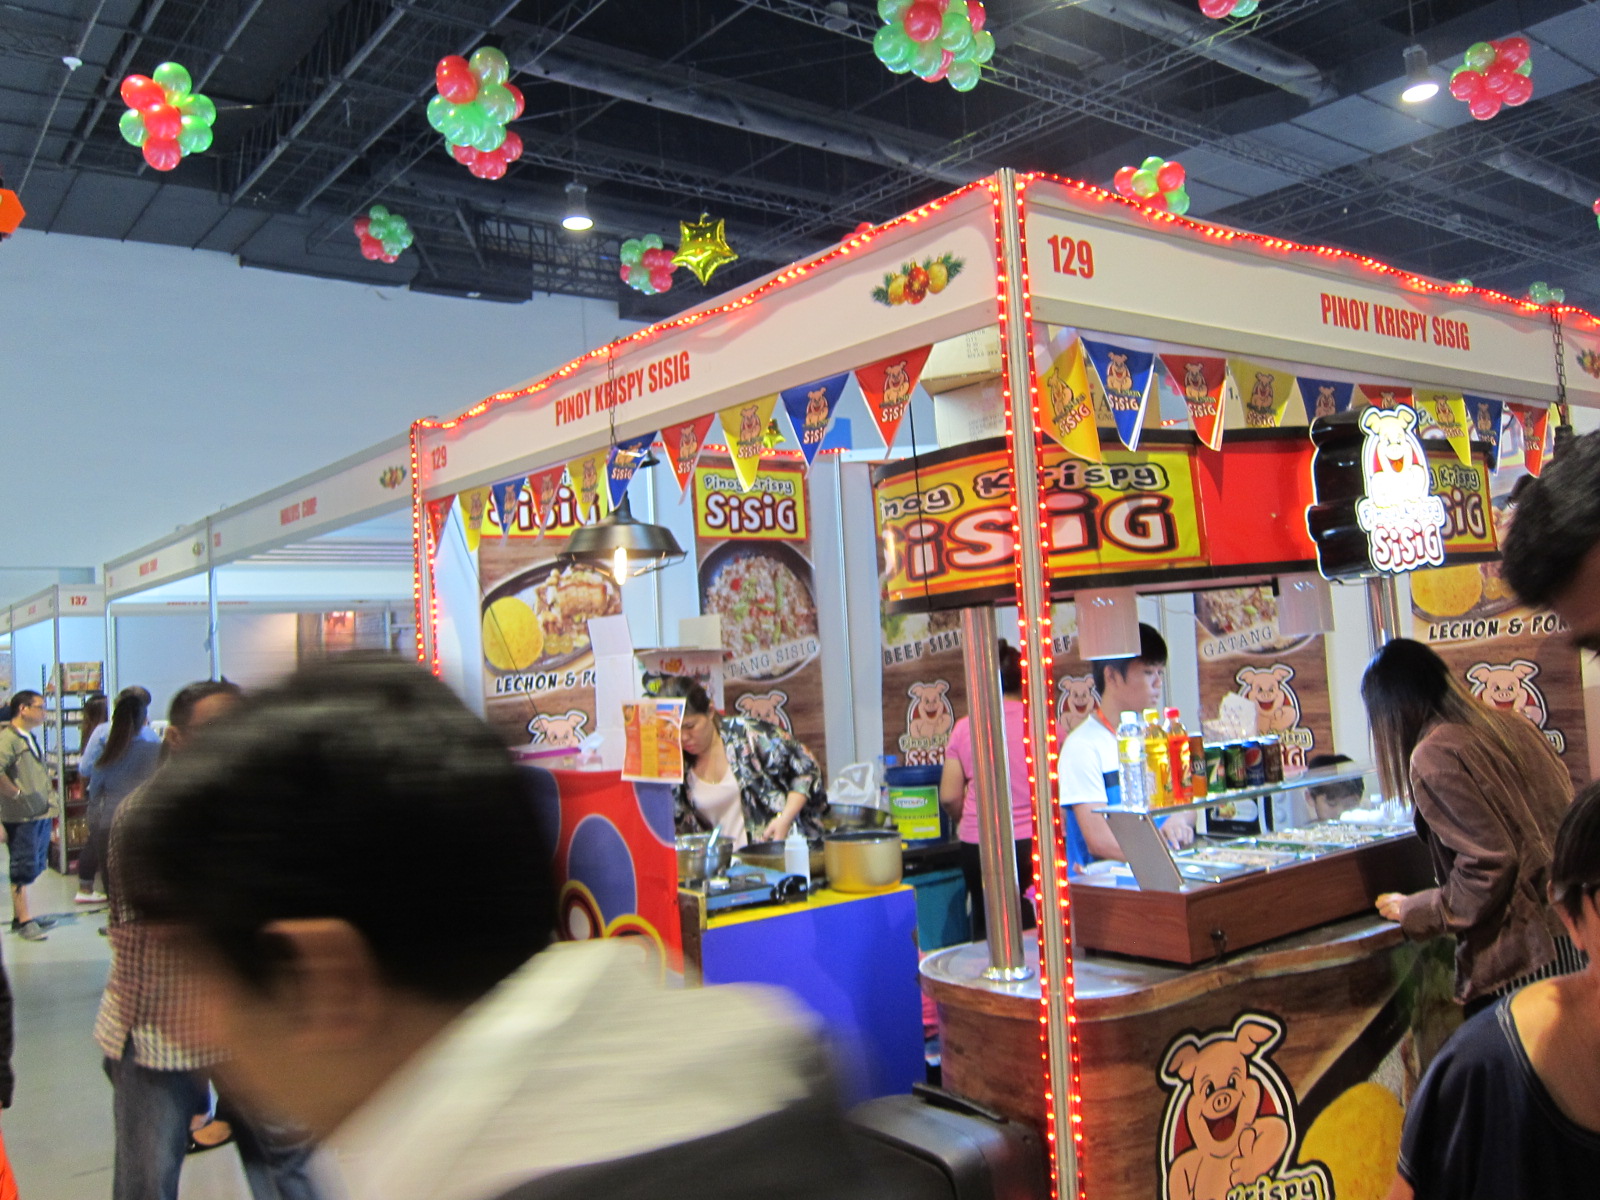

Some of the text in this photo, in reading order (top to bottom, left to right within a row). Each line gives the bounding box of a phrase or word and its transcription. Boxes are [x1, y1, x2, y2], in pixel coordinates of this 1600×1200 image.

[1048, 235, 1094, 279] 129
[1320, 293, 1470, 351] PINOY KRISPY SISIG
[555, 351, 690, 427] PINOY KRISPY SISIG
[432, 445, 447, 471] 129
[1204, 626, 1272, 657] GATANG
[1429, 619, 1500, 641] LECHON
[1508, 617, 1523, 636] &
[776, 640, 817, 664] SISIG
[884, 631, 962, 666] BEEF SISI
[496, 673, 558, 694] LECHON
[564, 671, 576, 688] &
